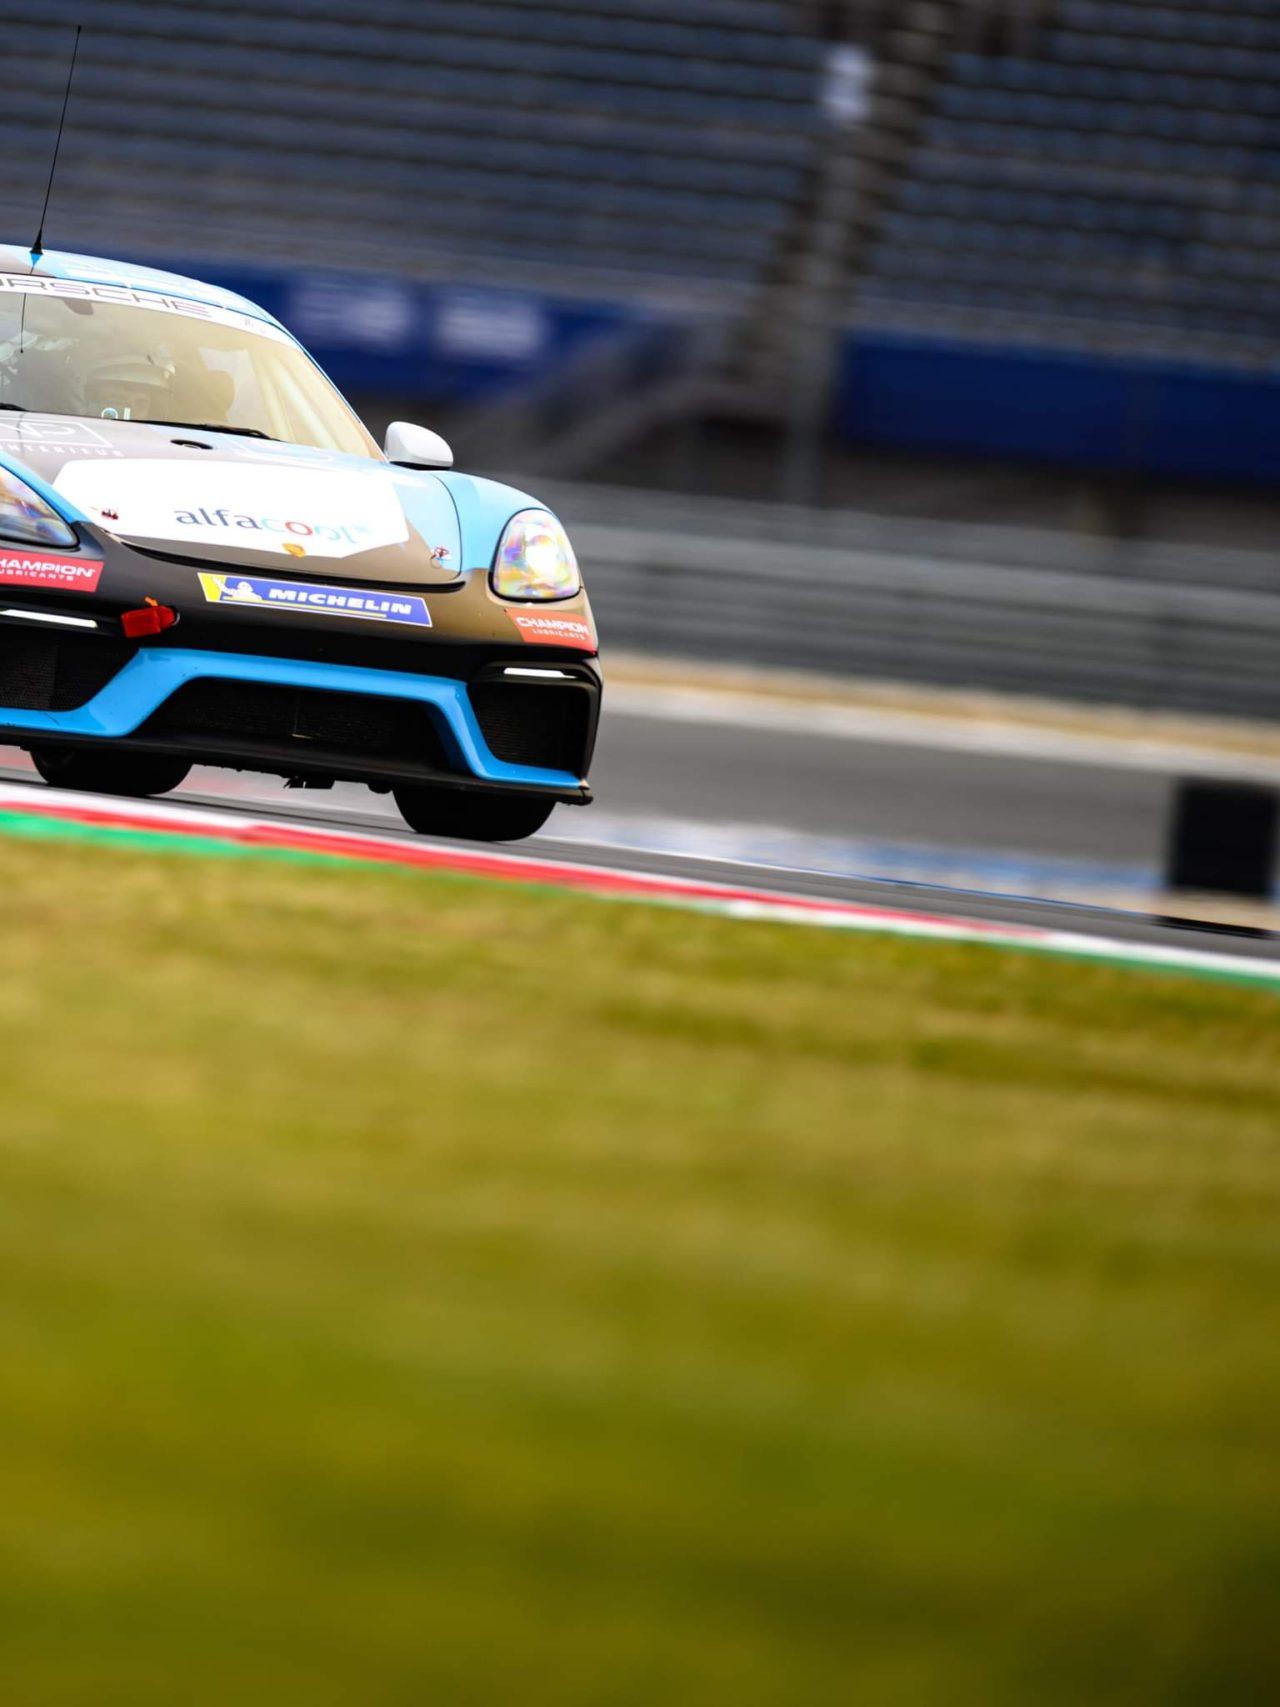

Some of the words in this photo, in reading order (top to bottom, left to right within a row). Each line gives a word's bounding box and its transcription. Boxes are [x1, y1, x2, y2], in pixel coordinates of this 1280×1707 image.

[174, 506, 357, 545] alfacool
[269, 587, 412, 616] MICHELIN
[515, 616, 590, 635] CHAMPION
